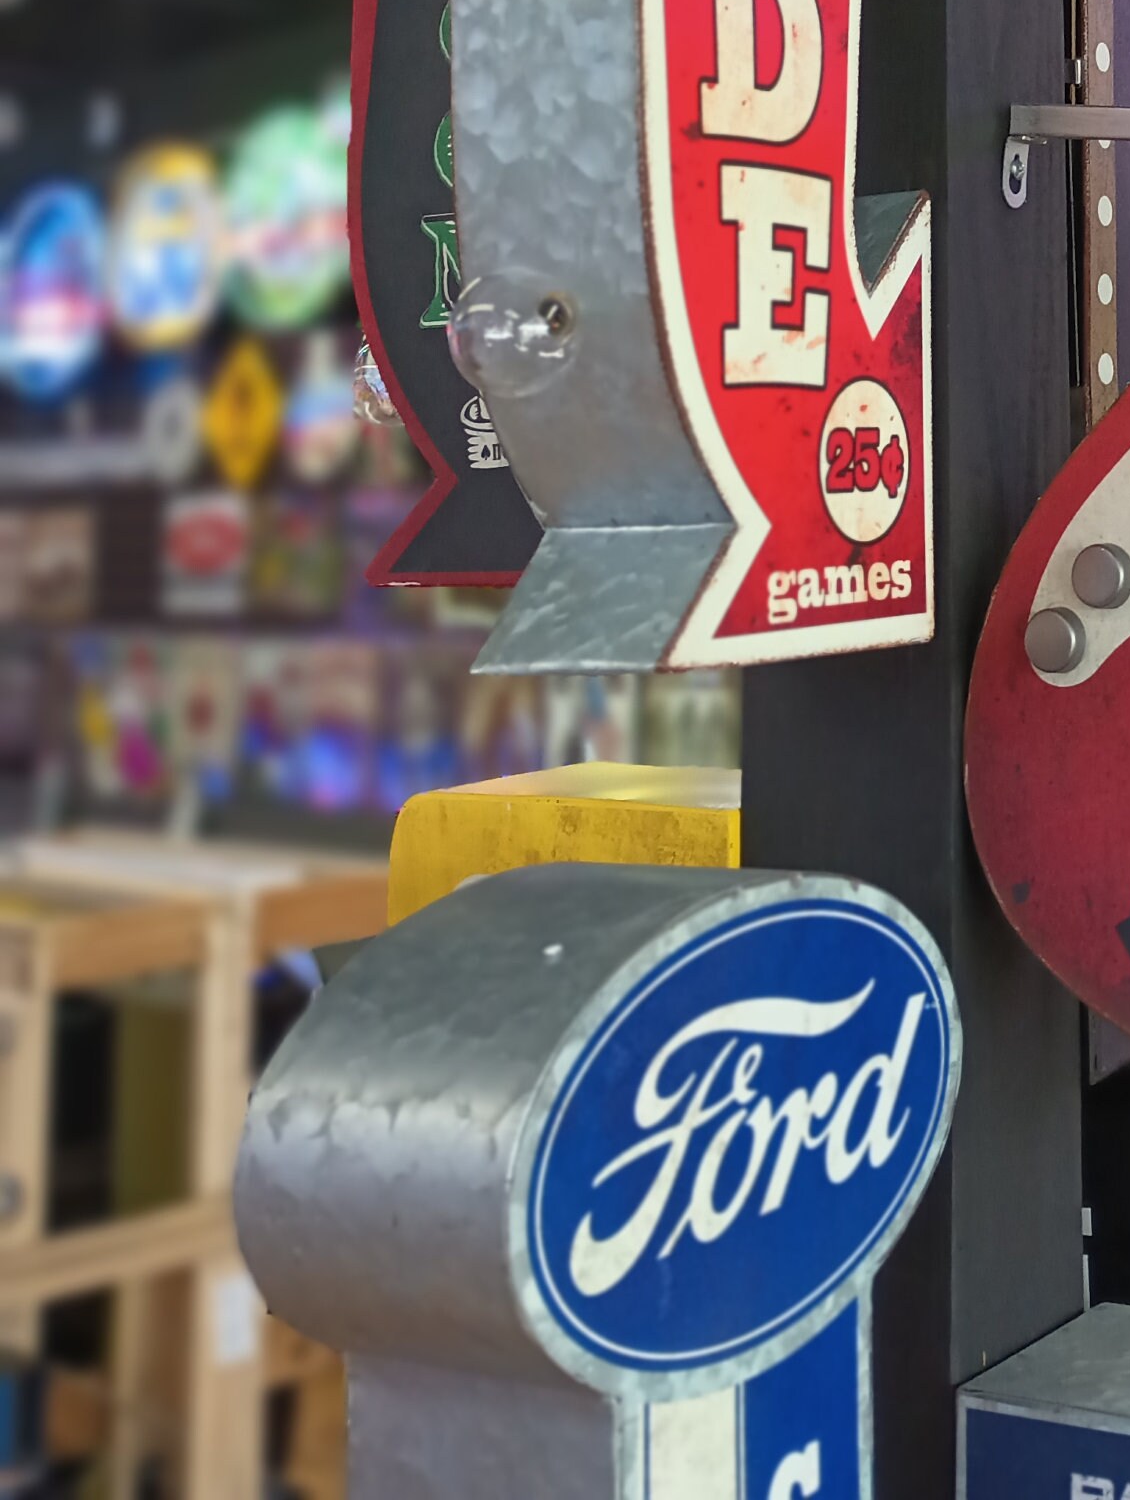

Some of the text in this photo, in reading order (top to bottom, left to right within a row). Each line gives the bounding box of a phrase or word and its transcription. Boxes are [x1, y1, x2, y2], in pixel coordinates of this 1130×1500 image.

[825, 427, 904, 498] 25¢
[767, 559, 912, 625] games
[570, 978, 926, 1297] Ford
